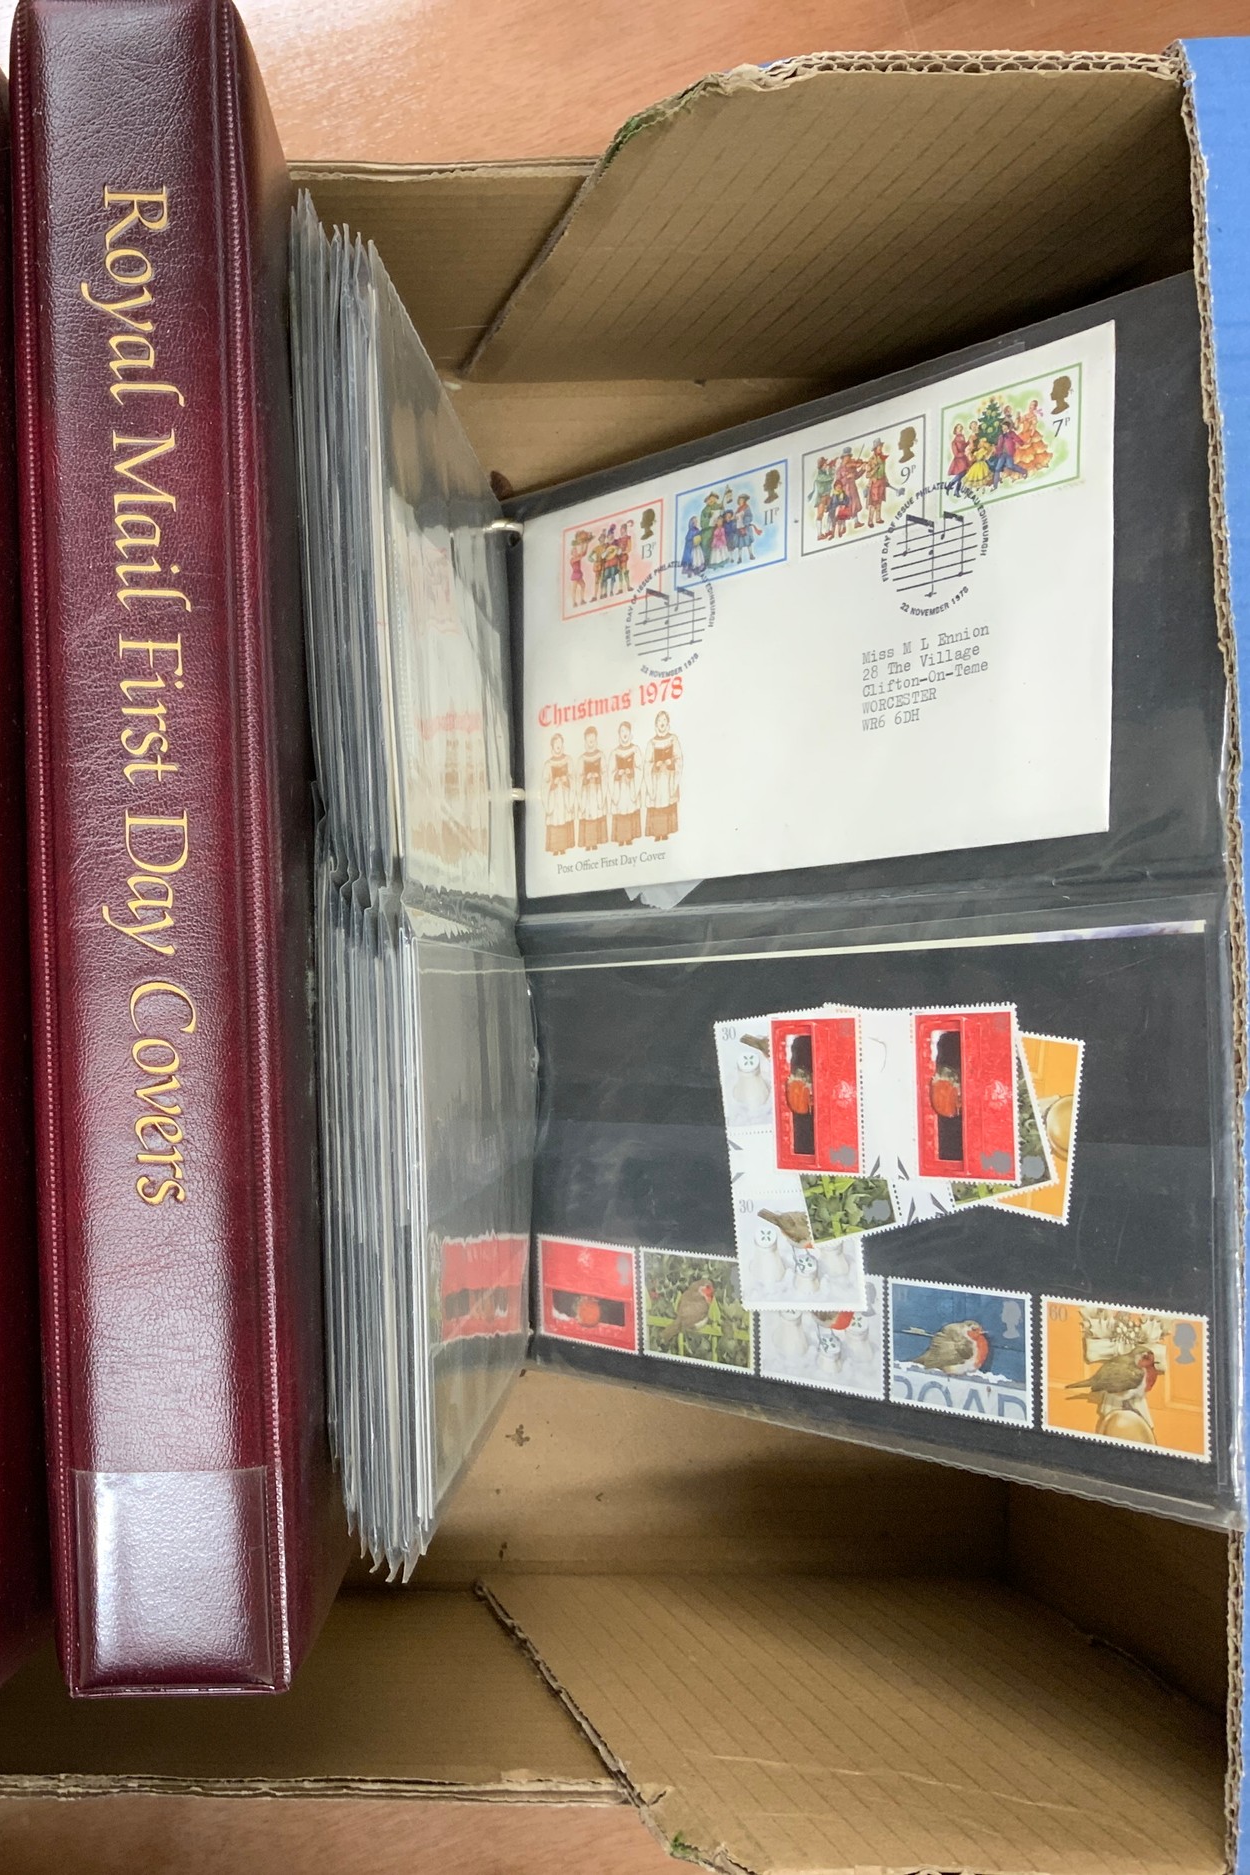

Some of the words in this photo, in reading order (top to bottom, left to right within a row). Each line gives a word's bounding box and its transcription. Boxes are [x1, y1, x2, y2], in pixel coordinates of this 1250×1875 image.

[80, 184, 185, 408] Royal
[112, 428, 192, 612] Mail
[895, 497, 914, 520] ISSUE
[882, 535, 891, 554] DAY
[881, 558, 889, 582] FIRST
[910, 602, 950, 617] NOVEMBER
[862, 648, 894, 665] Miss
[903, 641, 912, 655] M
[920, 638, 930, 651] L
[937, 625, 990, 646] Ennion
[862, 665, 878, 681] 28
[888, 661, 911, 675] The
[920, 645, 980, 667] Village
[118, 632, 184, 786] First
[538, 689, 632, 728] Christmas
[638, 676, 684, 706] 1978
[862, 687, 937, 714] WORCESTER
[862, 714, 886, 732] WR6
[894, 708, 920, 725] 6DH
[557, 863, 573, 875] Post
[575, 858, 599, 872] Office
[600, 856, 618, 869] First
[620, 854, 638, 867] Day
[639, 851, 667, 864] Cover
[101, 808, 190, 957] Day
[721, 1026, 736, 1041] 30
[129, 980, 198, 1206] Covers
[739, 1199, 754, 1214] 30
[1048, 1306, 1069, 1323] 60
